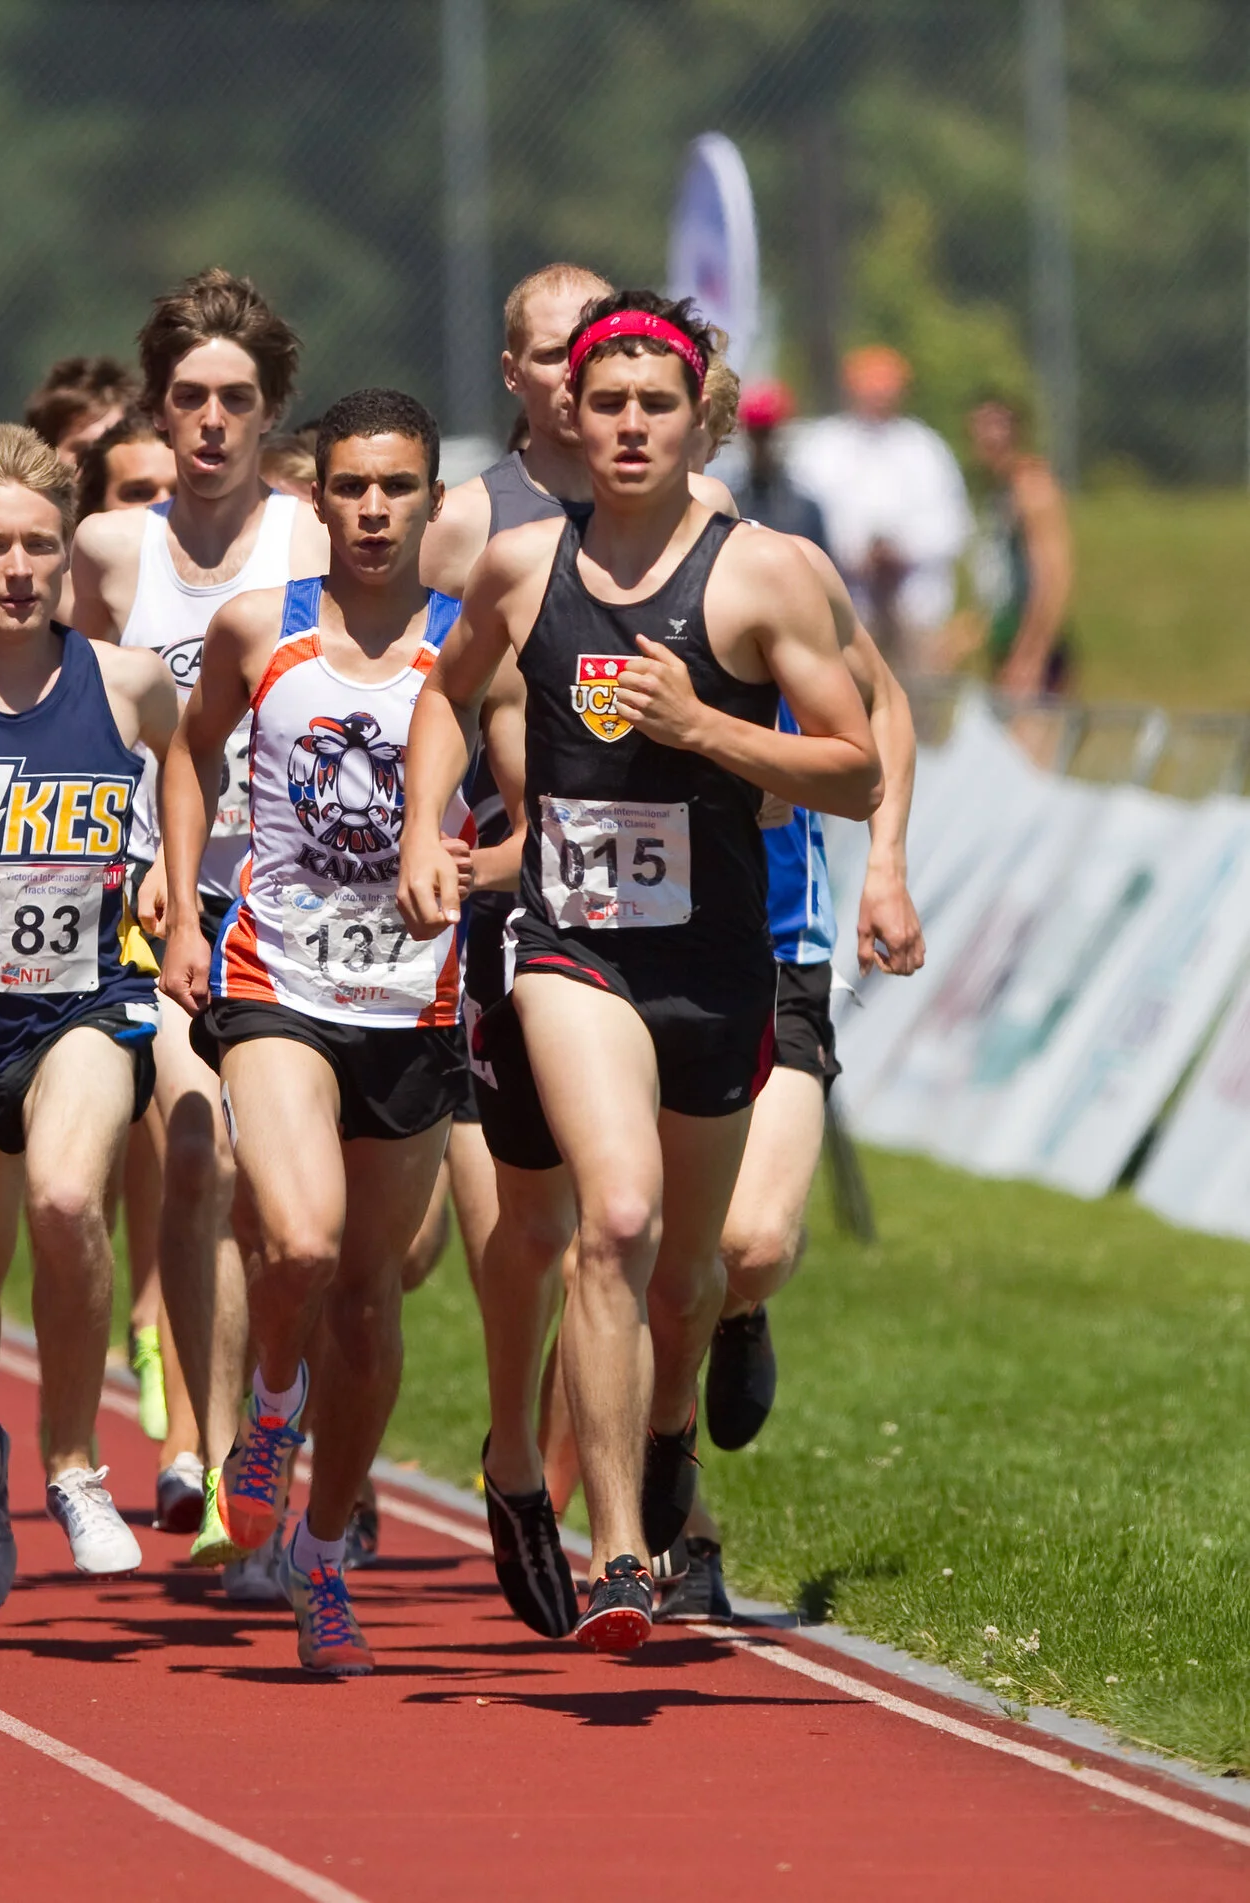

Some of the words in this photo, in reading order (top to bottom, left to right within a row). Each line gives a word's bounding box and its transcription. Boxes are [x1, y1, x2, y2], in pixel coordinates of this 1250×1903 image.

[170, 643, 204, 678] CA
[570, 684, 619, 715] UCA
[613, 807, 671, 818] International
[294, 842, 400, 886] KAJAK
[560, 837, 667, 890] 015
[6, 871, 37, 882] Victoria
[39, 872, 91, 883] International
[24, 885, 47, 895] Track
[48, 885, 79, 896] Classic
[334, 892, 367, 902] Victoria
[605, 901, 645, 916] NTL
[305, 923, 407, 974] 137
[19, 967, 54, 983] NTL
